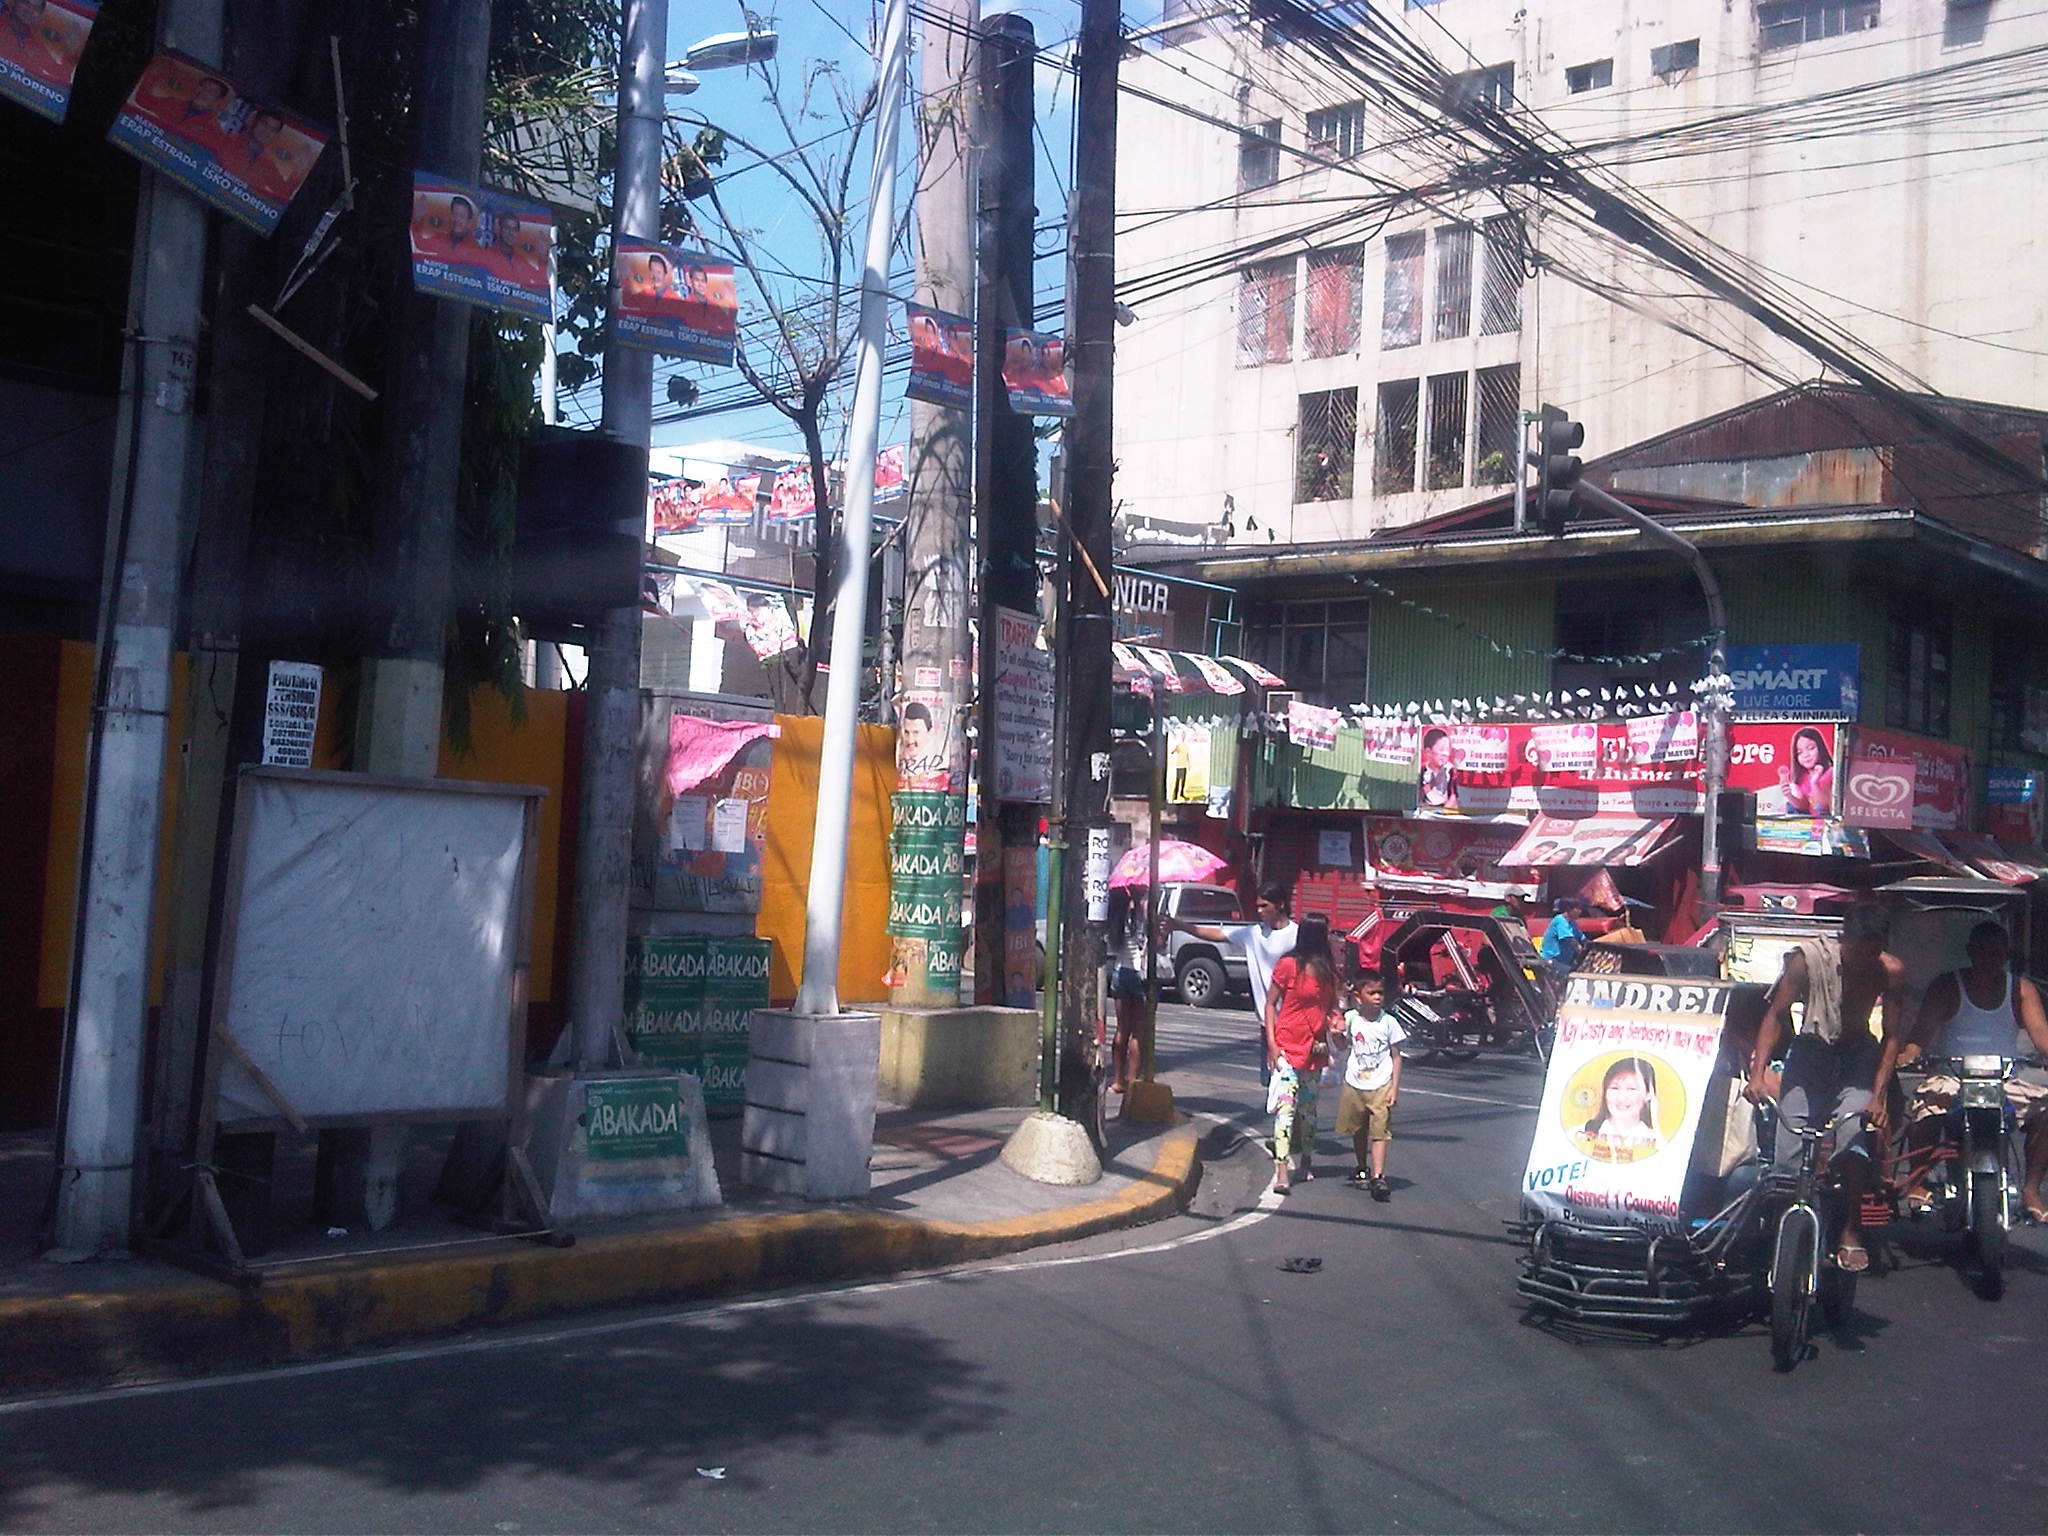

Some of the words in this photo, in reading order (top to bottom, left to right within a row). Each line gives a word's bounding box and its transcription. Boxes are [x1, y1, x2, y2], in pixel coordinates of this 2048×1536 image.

[9, 71, 65, 103] MORENO
[120, 116, 152, 139] ERAP
[151, 136, 198, 169] ESTRADA
[202, 167, 232, 190] ISKO
[231, 186, 279, 220] MORENO
[416, 264, 442, 277] ERAP
[443, 271, 483, 289] ESTRADA
[487, 282, 511, 296] ISKO
[511, 288, 550, 307] MORENO
[618, 320, 640, 333] ERAP
[641, 324, 675, 339] ESTRADA
[1731, 669, 1828, 692] SMART
[1743, 694, 1770, 708] LIVE
[1773, 694, 1811, 708] MORE
[1465, 761, 1480, 769] VICE
[1481, 761, 1506, 769] MAYOR
[1552, 761, 1566, 769] VICE
[1568, 760, 1594, 769] MAYOR
[1667, 748, 1696, 758] MAYOR
[1849, 806, 1906, 818] SELECTA
[641, 952, 705, 977] ABAKADA
[706, 952, 769, 978] ABAKADA
[1567, 978, 1721, 1015] ANDREI
[636, 1009, 700, 1033] ABAKADA
[703, 1009, 752, 1033] ABAKA
[590, 1103, 678, 1136] ABAKADA
[1528, 1160, 1589, 1190] VOTE!
[1565, 1184, 1610, 1210] District
[1613, 1191, 1621, 1211] 1
[1624, 1191, 1679, 1218] Councilo
